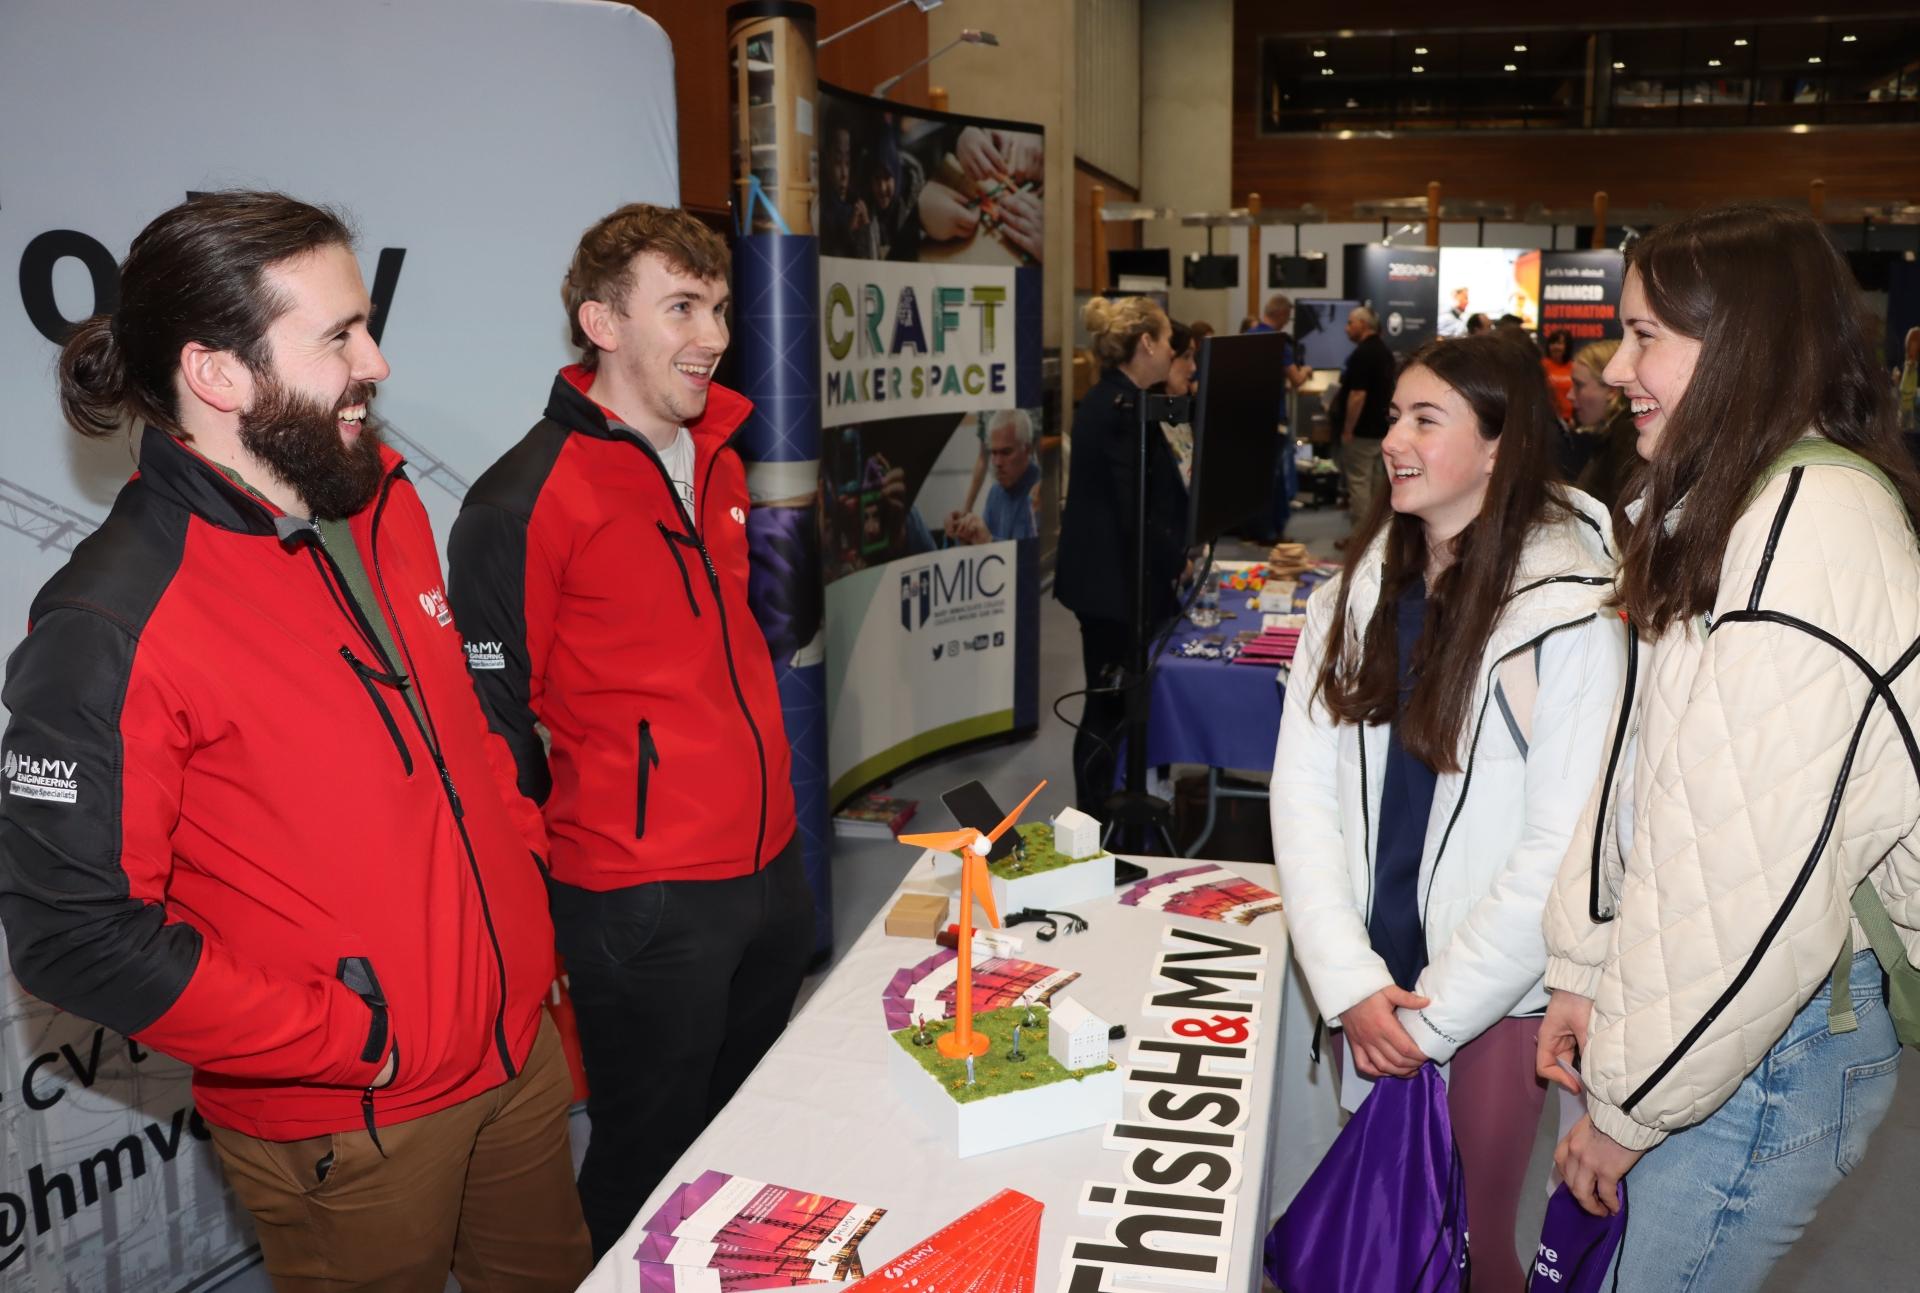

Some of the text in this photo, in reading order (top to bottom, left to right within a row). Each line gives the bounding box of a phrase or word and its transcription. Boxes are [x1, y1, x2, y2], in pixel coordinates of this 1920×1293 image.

[1580, 267, 1605, 278] about
[1543, 284, 1604, 301] ADVANCED
[825, 282, 1007, 361] CRAFT
[1543, 303, 1616, 320] AUTOMATION
[1543, 323, 1605, 338] STIONS
[827, 363, 1006, 407] MAKER SPACE
[933, 554, 1006, 607] MIC
[18, 753, 78, 780] H&MV
[16, 772, 78, 790] ENGINEERING
[22, 1027, 105, 1111] CV
